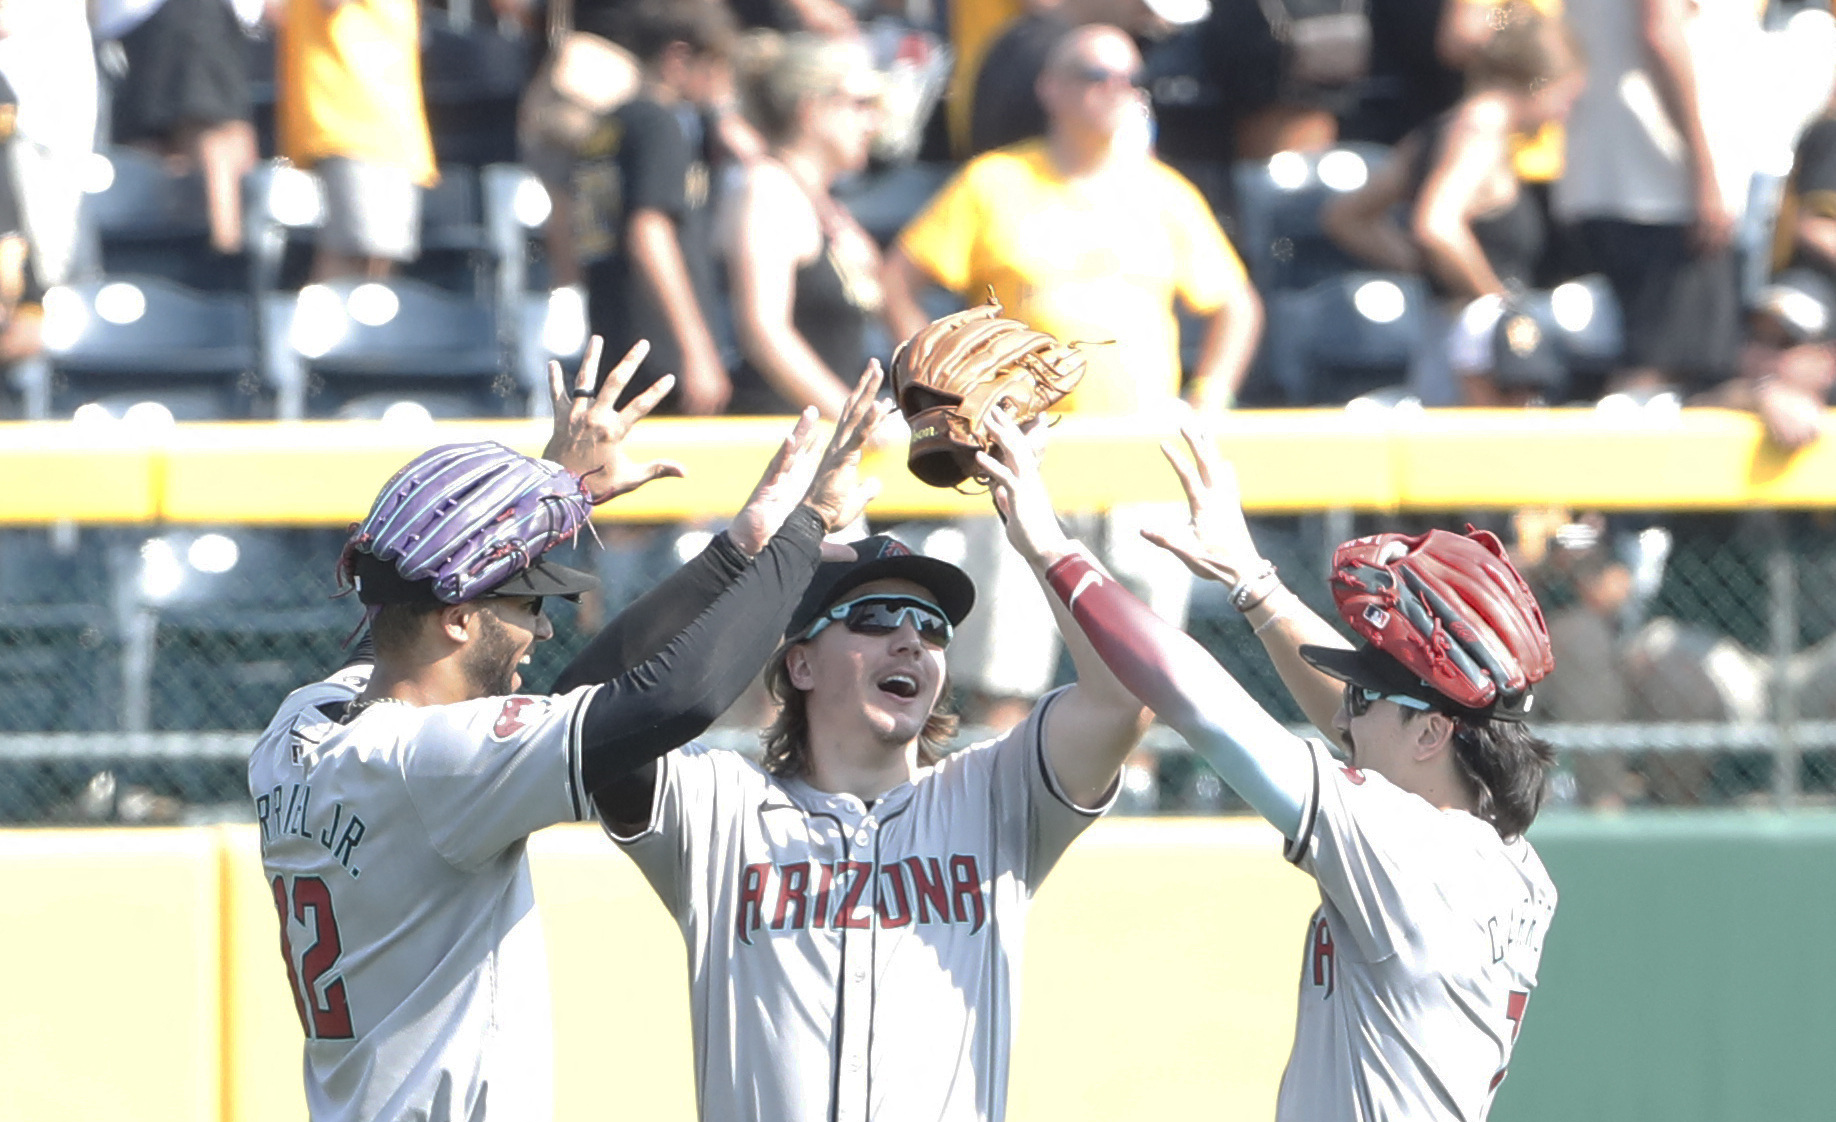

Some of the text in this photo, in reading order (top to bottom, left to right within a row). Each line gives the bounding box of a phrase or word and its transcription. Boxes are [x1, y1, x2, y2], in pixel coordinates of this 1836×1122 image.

[320, 803, 366, 878] JR.
[737, 854, 986, 946] ARIZONA
[272, 874, 357, 1040] 12
